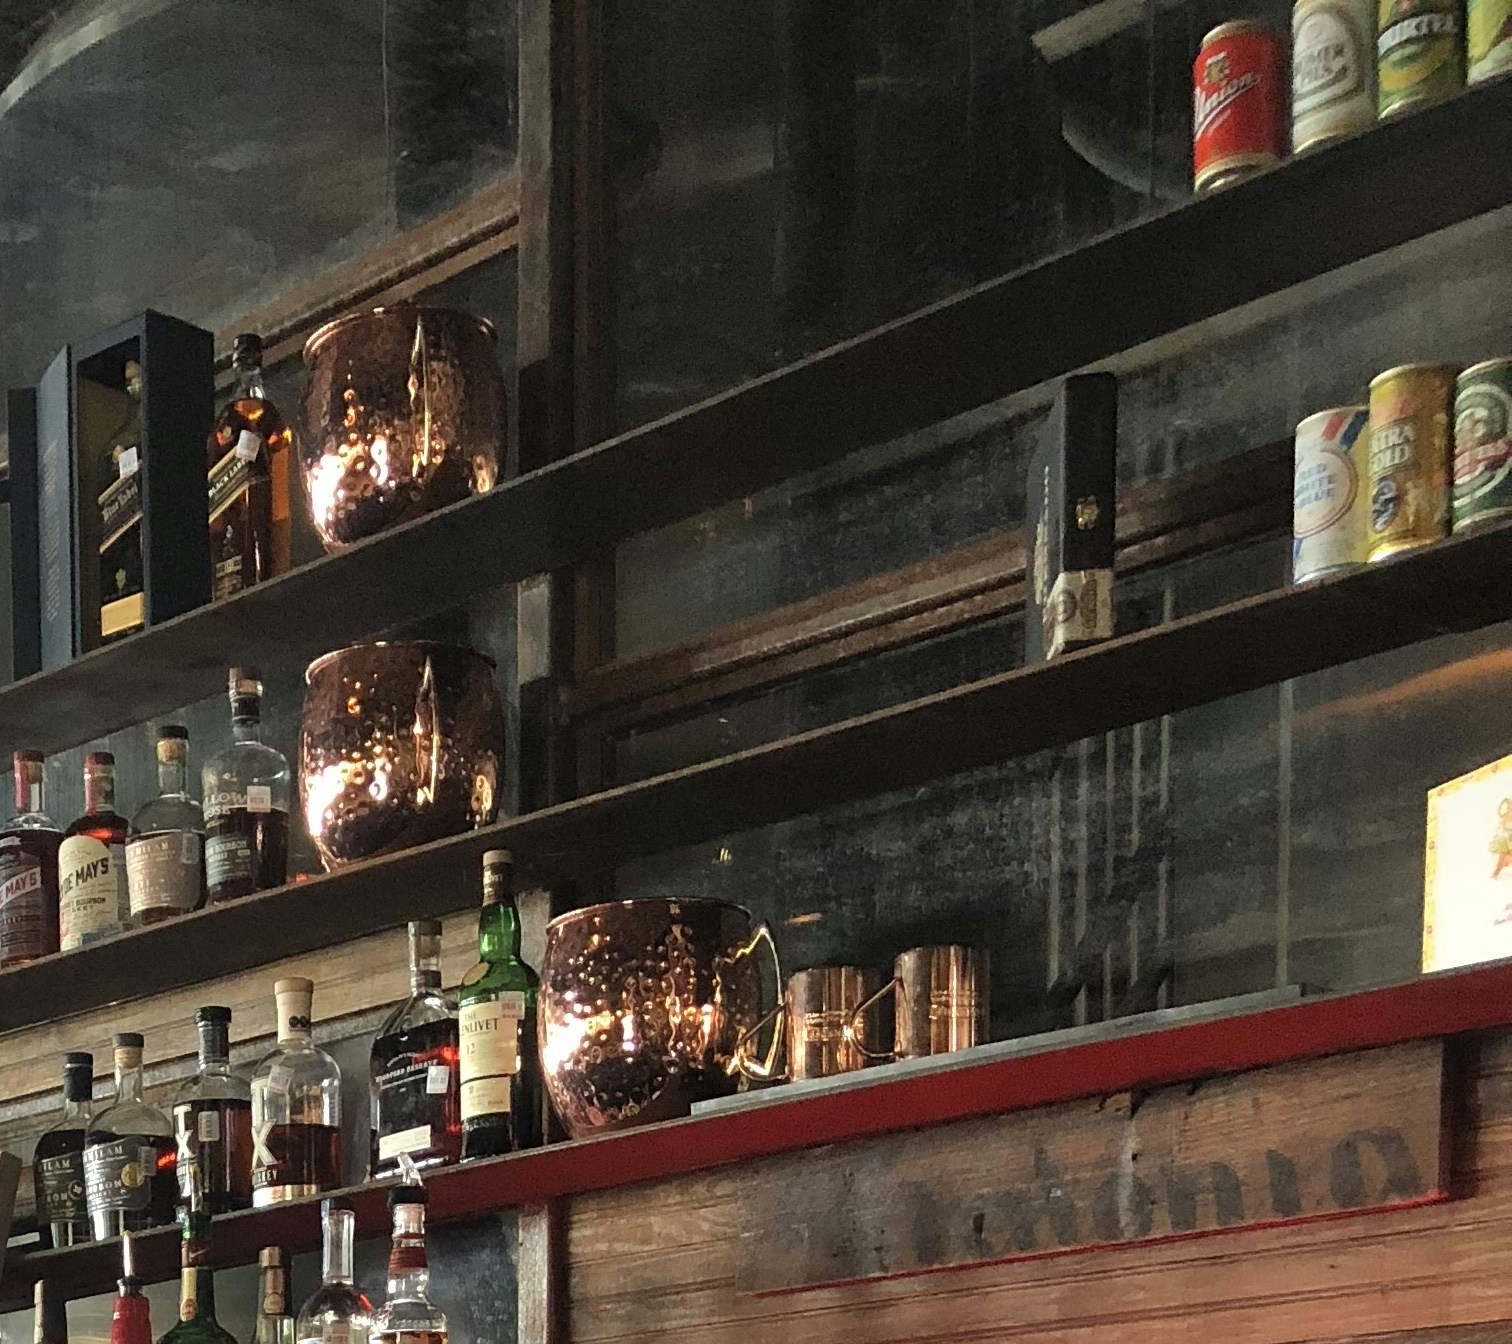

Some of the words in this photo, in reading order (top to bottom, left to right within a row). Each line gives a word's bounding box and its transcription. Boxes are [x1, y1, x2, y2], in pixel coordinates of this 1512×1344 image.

[5, 871, 37, 898] MAY'S
[75, 856, 110, 887] MAY'S
[42, 1159, 71, 1171] ILAM
